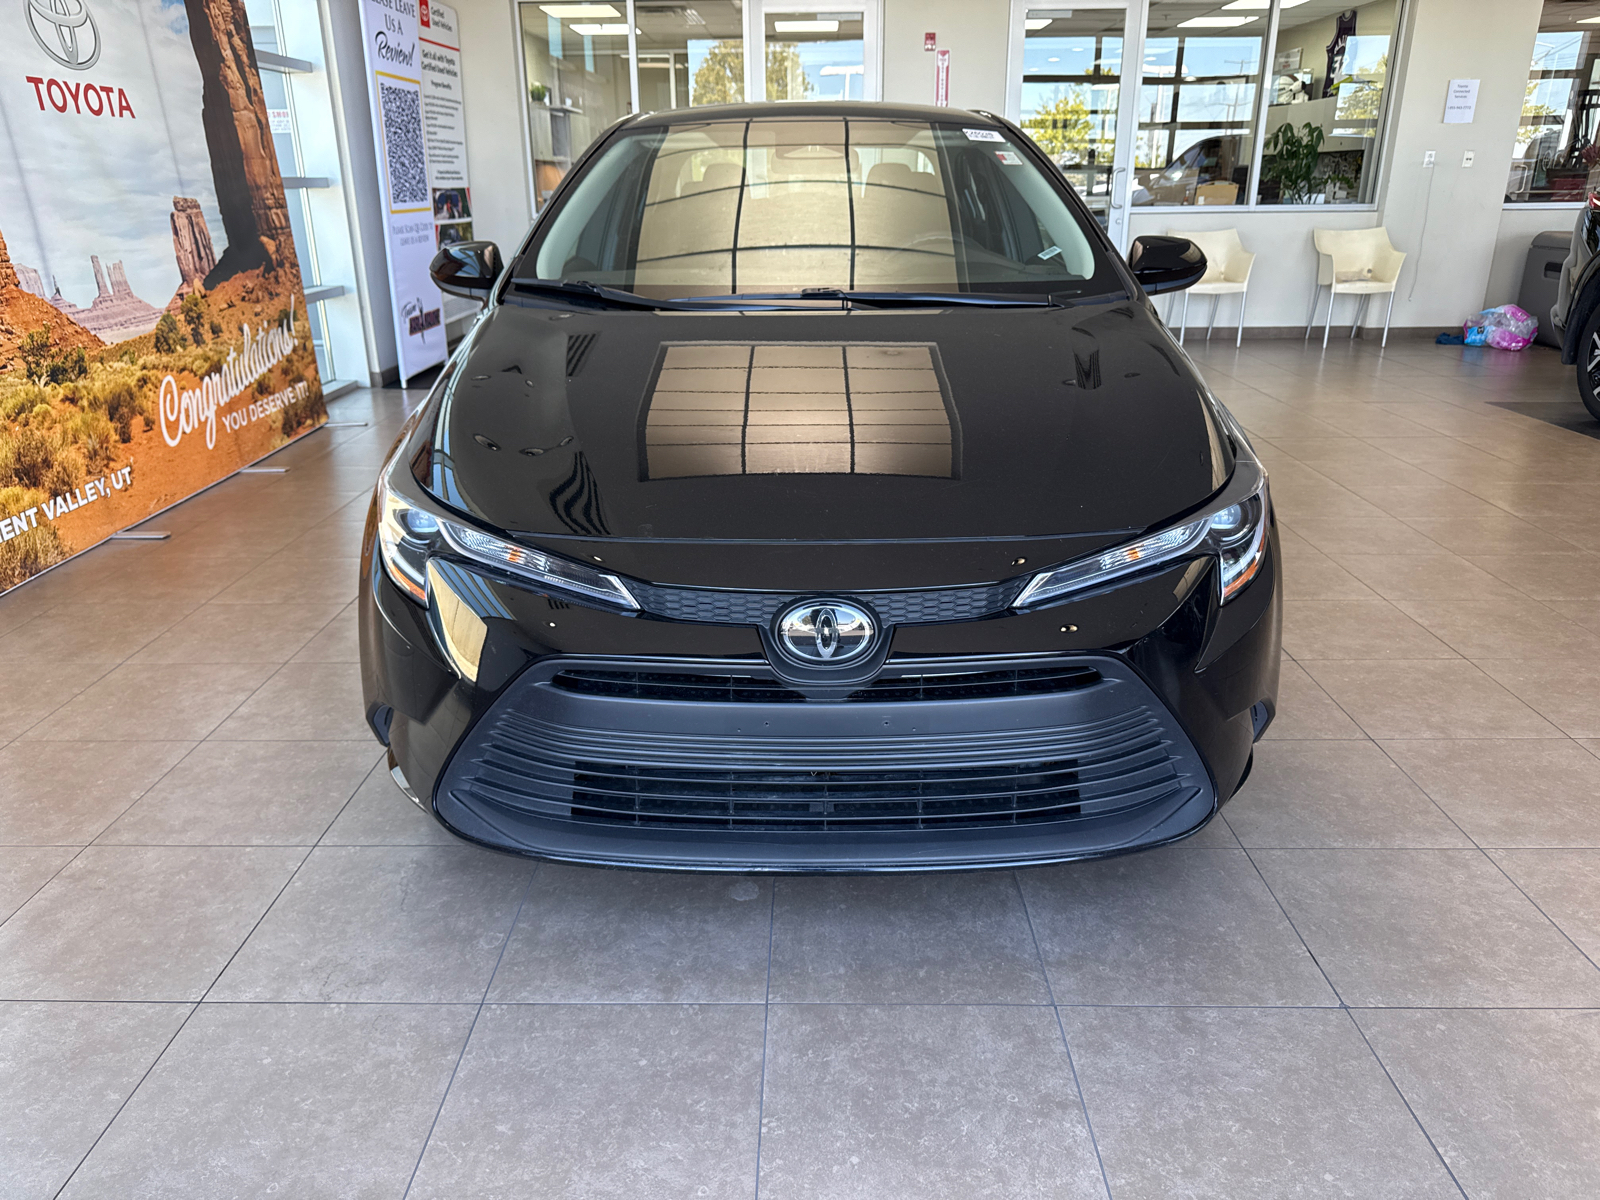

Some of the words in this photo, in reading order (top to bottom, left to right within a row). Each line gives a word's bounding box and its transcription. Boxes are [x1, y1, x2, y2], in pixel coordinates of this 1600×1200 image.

[374, 30, 415, 67] Review!
[397, 19, 404, 35] A
[25, 75, 137, 119] TOYOTA
[159, 293, 299, 450] Congratulations!
[221, 408, 248, 433] YOU
[249, 386, 296, 421] DESERVE
[294, 380, 309, 402] IT!
[41, 477, 111, 521] VALLEY,
[110, 466, 132, 490] UT
